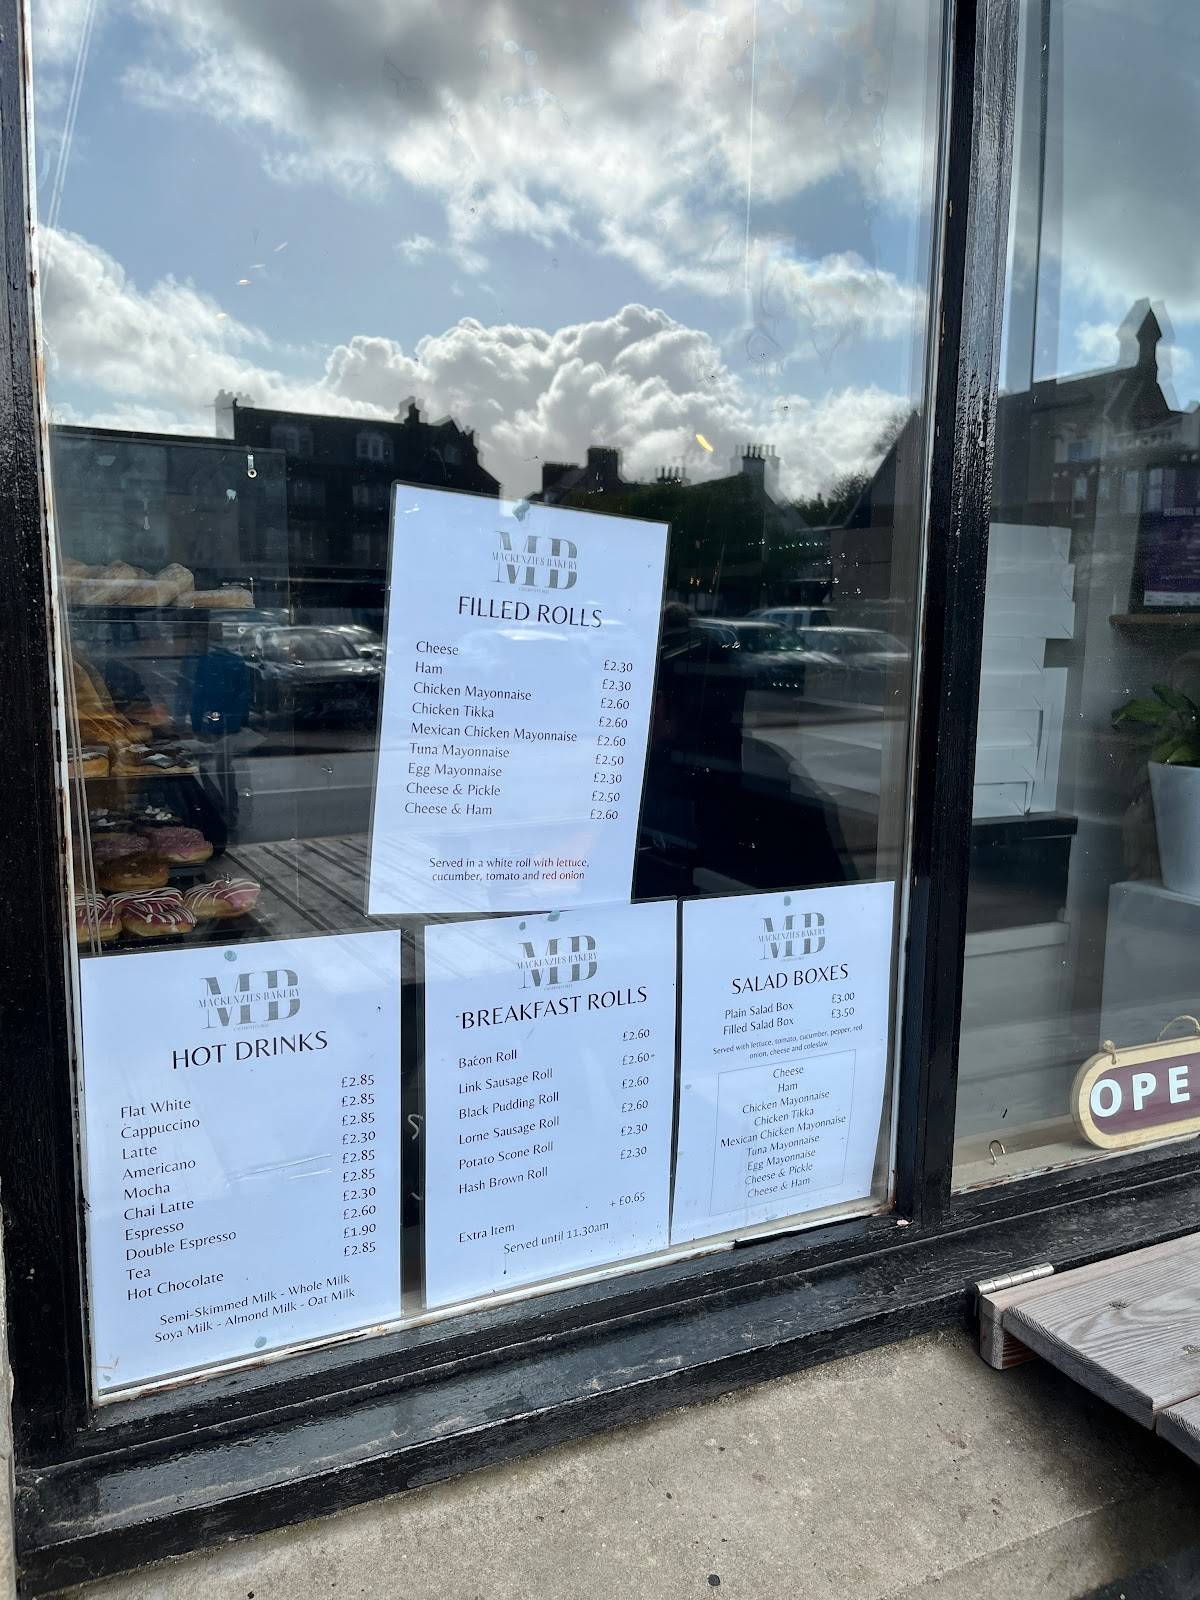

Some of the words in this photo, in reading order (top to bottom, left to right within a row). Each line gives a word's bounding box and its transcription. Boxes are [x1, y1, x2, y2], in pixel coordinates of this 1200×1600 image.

[458, 596, 530, 621] FILLED
[537, 604, 602, 628] ROLLS
[416, 641, 459, 656] Cheese
[415, 661, 443, 675] Ham
[603, 659, 633, 673] £2.30
[413, 681, 461, 696] Chicken
[465, 685, 532, 701] Mayonnaise
[602, 678, 631, 692] £2.30
[412, 702, 459, 716] Chicken
[463, 705, 494, 718] Tikka
[600, 697, 630, 710] £2.60
[598, 716, 628, 729] £2.60
[411, 722, 460, 736] Mexican
[464, 725, 510, 739] Chicken
[513, 728, 578, 743] Mayonnaise
[597, 734, 626, 747] £2.60
[409, 742, 438, 755] Tuna
[442, 744, 510, 759] Mayonnaise
[595, 753, 624, 766] £2.50
[408, 762, 430, 778] Egg
[435, 763, 502, 778] Mayonnaise
[593, 772, 622, 785] £2.30
[406, 782, 449, 795] Cheese
[468, 784, 500, 796] Pickle
[591, 790, 620, 803] £2.50
[404, 802, 447, 814] Cheese
[466, 803, 492, 815] Ham
[590, 809, 618, 820] £2.60
[429, 857, 463, 868] Served
[486, 857, 514, 868] white
[515, 857, 531, 868] roll
[533, 857, 554, 867] with
[556, 857, 589, 868] lettuce,
[432, 871, 482, 881] cucumber,
[486, 873, 520, 881] tomato
[522, 870, 540, 880] and
[542, 870, 557, 880] red
[559, 870, 585, 880] onion
[731, 972, 788, 995] SALAD
[794, 963, 848, 986] BOXES
[831, 992, 855, 1004] £3.00
[462, 995, 582, 1030] BREAKFAST
[588, 986, 647, 1011] ROLLS
[725, 1008, 747, 1020] Plain
[749, 1003, 774, 1016] Salad
[776, 1002, 794, 1012] Box
[831, 1007, 855, 1019] £3.50
[723, 1022, 748, 1036] Filled
[750, 1018, 774, 1031] Salad
[777, 1017, 794, 1027] Box
[622, 1028, 650, 1042] £2.60
[713, 1045, 734, 1055] Served
[735, 1042, 749, 1050] with
[751, 1040, 773, 1048] lettuce,
[775, 1036, 798, 1044] tomato,
[799, 1031, 829, 1041] cucumber,
[830, 1028, 852, 1037] pepper,
[853, 1023, 863, 1031] red
[172, 1043, 227, 1070] HOT
[236, 1030, 328, 1061] DRINKS
[749, 1051, 769, 1059] onion,
[769, 1048, 790, 1056] cheese
[791, 1043, 803, 1052] and
[804, 1042, 828, 1050] coleslaw
[459, 1055, 492, 1069] Bacon
[496, 1049, 517, 1063] Roll
[622, 1052, 650, 1066] £2.60
[341, 1074, 375, 1088] £2.85
[459, 1080, 482, 1094] Link
[485, 1075, 529, 1090] Sausage
[532, 1068, 552, 1081] Roll
[773, 1067, 804, 1079] Cheese
[622, 1076, 649, 1089] £2.60
[778, 1083, 798, 1093] Ham
[1090, 1065, 1191, 1118] OPE
[341, 1093, 375, 1108] £2.85
[459, 1104, 489, 1120] Black
[492, 1098, 535, 1113] Pudding
[539, 1091, 559, 1105] Roll
[621, 1099, 649, 1113] £2.60
[742, 1101, 777, 1114] Chicken
[781, 1091, 830, 1107] Mayonnaise
[121, 1105, 146, 1119] Flat
[150, 1099, 191, 1114] White
[754, 1113, 789, 1126] Chicken
[791, 1108, 814, 1119] Tikka
[342, 1112, 375, 1126] £2.85
[121, 1119, 200, 1140] Cappuccino
[342, 1130, 376, 1145] £2.30
[459, 1132, 490, 1145] Lorne
[493, 1123, 536, 1138] Sausage
[539, 1116, 559, 1129] Roll
[621, 1123, 648, 1136] £2.30
[721, 1134, 757, 1148] Mexican
[760, 1127, 795, 1140] Chicken
[797, 1116, 846, 1132] Mayonnaise
[122, 1146, 157, 1160] Latte
[620, 1146, 647, 1160] £2.30
[748, 1146, 767, 1157] Tuna
[770, 1135, 820, 1153] Mayonnaise
[342, 1149, 375, 1164] £2.85
[459, 1155, 495, 1170] Potato
[498, 1148, 530, 1162] Scone
[533, 1141, 553, 1155] Roll
[747, 1161, 764, 1172] Egg
[767, 1150, 814, 1167] Mayonnaise
[122, 1160, 196, 1180] Americano
[343, 1168, 375, 1183] £2.85
[745, 1172, 776, 1185] Cheese
[789, 1162, 812, 1175] Pickle
[459, 1180, 485, 1194] Hash
[489, 1174, 524, 1188] Brown
[527, 1166, 548, 1180] Roll
[747, 1186, 778, 1198] Cheese
[791, 1178, 810, 1188] Ham
[124, 1183, 170, 1200] Mocha
[343, 1186, 376, 1202] £2.30
[619, 1191, 645, 1206] £0.65
[124, 1205, 155, 1220] Chai
[160, 1200, 194, 1214] Latte
[343, 1204, 376, 1220] £2.60
[125, 1222, 184, 1241] Espresso
[343, 1223, 376, 1239] £1.90
[459, 1230, 487, 1243] Extra
[491, 1224, 515, 1236] Item
[504, 1237, 538, 1254] Served
[541, 1231, 563, 1245] until
[567, 1222, 609, 1239] 11.30am
[126, 1242, 175, 1261] Double
[180, 1231, 237, 1250] Espresso
[344, 1241, 376, 1257] £2.85
[125, 1268, 151, 1281] Tea
[127, 1287, 153, 1301] Hot
[157, 1273, 224, 1294] Chocolate
[160, 1296, 248, 1326] Semi-Skimmed
[252, 1291, 277, 1304] Milk
[288, 1281, 323, 1295] Whole
[326, 1274, 350, 1287] Milk
[154, 1330, 183, 1343] Soya
[187, 1321, 213, 1335] Milk
[225, 1307, 269, 1327] Almond
[272, 1301, 297, 1316] Milk
[308, 1296, 327, 1307] Oat
[331, 1288, 355, 1301] Milk
